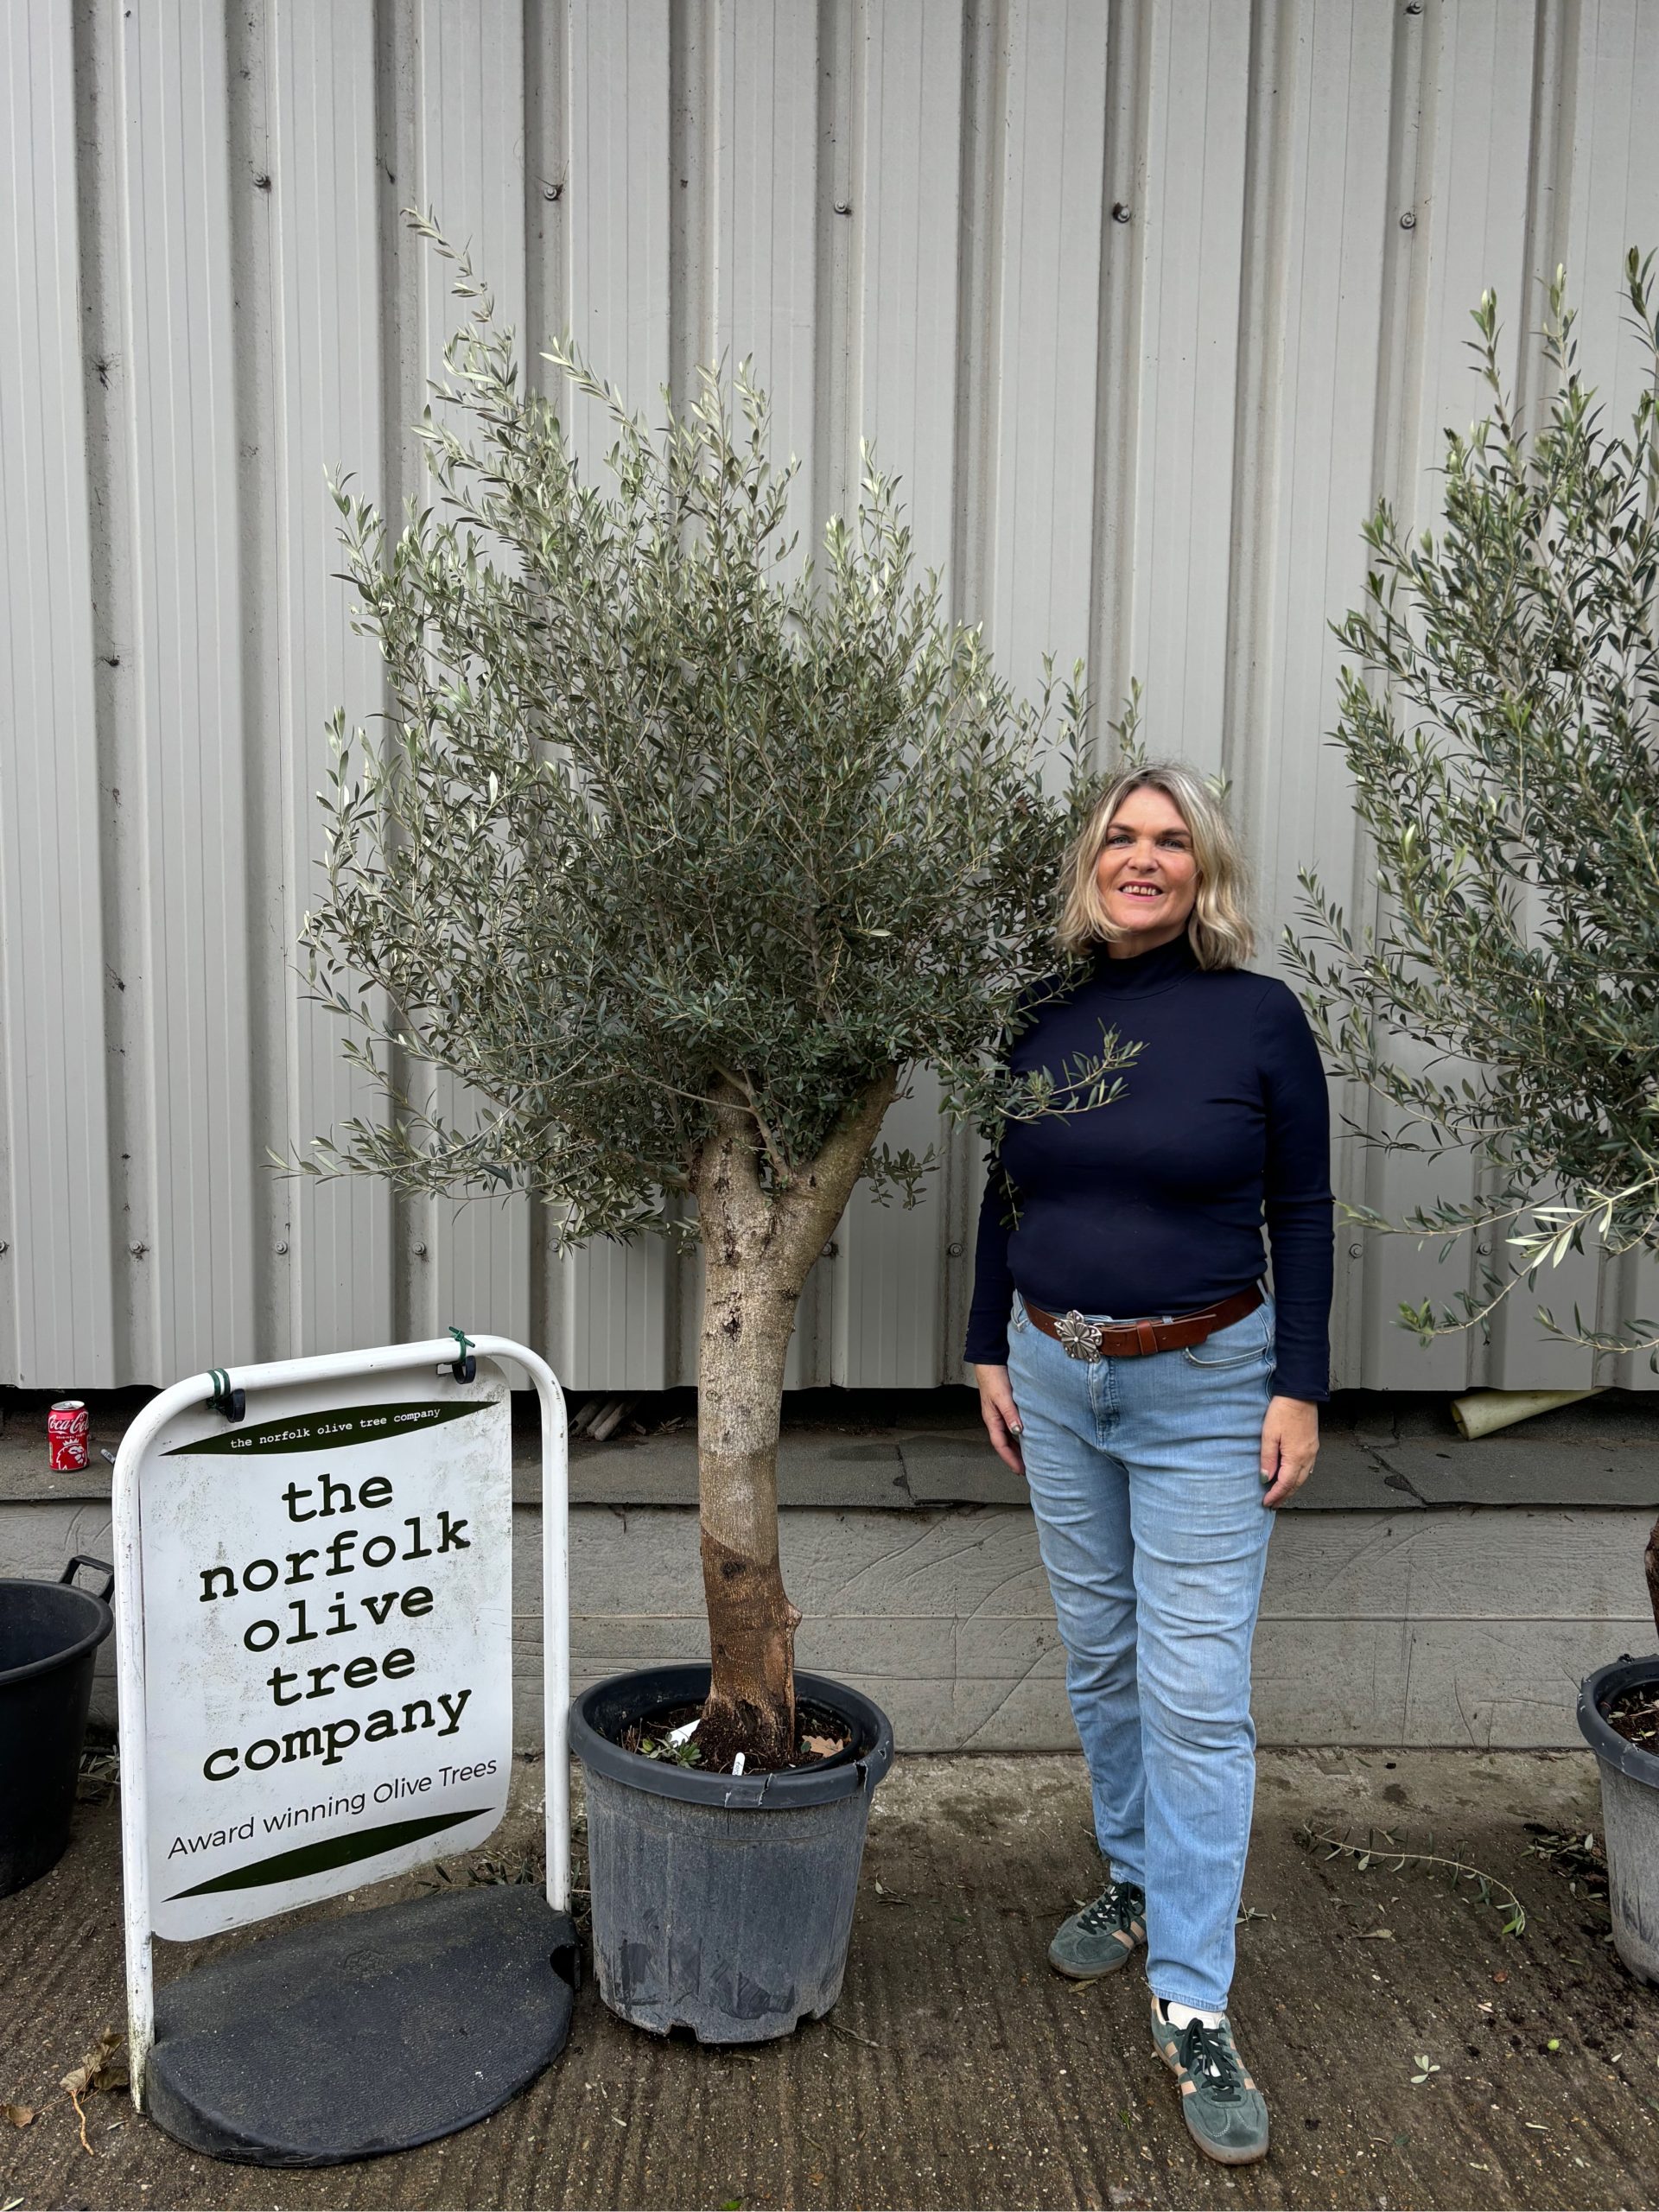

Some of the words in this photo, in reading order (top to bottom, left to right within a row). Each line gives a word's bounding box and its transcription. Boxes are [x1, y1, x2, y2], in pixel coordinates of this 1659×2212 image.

[230, 1439, 252, 1448] the
[259, 1429, 311, 1445] norfolk
[317, 1423, 353, 1435] olive
[359, 1418, 387, 1428] tree
[393, 1408, 441, 1423] company
[282, 1474, 393, 1522] the
[200, 1510, 472, 1603] norfolk
[243, 1592, 434, 1653] olive
[267, 1647, 416, 1707] tree
[203, 1688, 473, 1782] company
[168, 1815, 255, 1859] Award
[263, 1792, 365, 1834] winning
[373, 1775, 432, 1804] Olive
[438, 1758, 498, 1788] Trees
